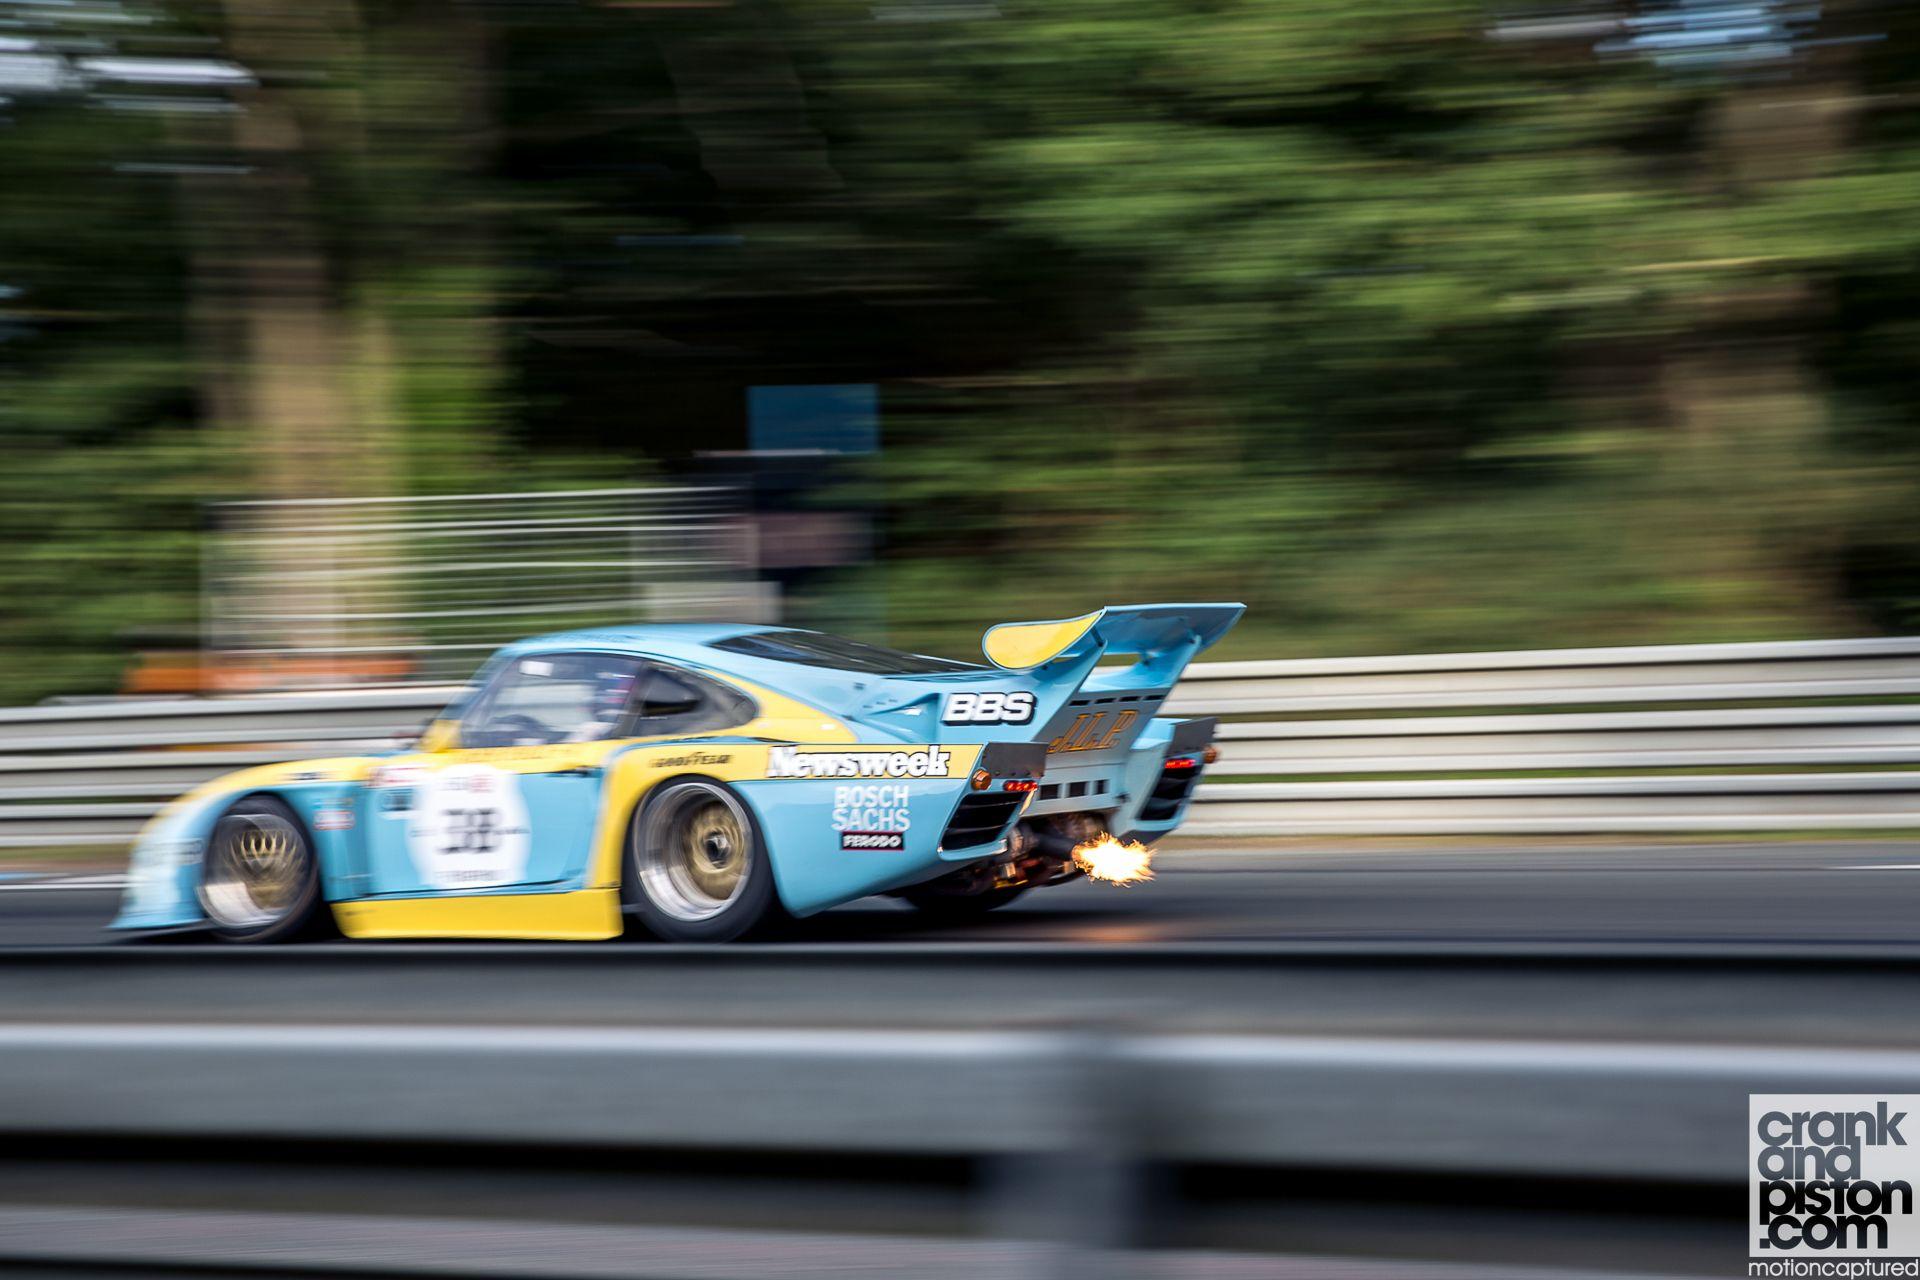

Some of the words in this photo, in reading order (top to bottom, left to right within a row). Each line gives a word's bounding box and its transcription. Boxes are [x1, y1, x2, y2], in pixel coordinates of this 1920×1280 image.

[941, 692, 1037, 726] BBS
[766, 744, 951, 777] Newsweek
[834, 785, 909, 808] BOSCH
[831, 808, 911, 831] SACHS
[842, 834, 903, 848] FERODO
